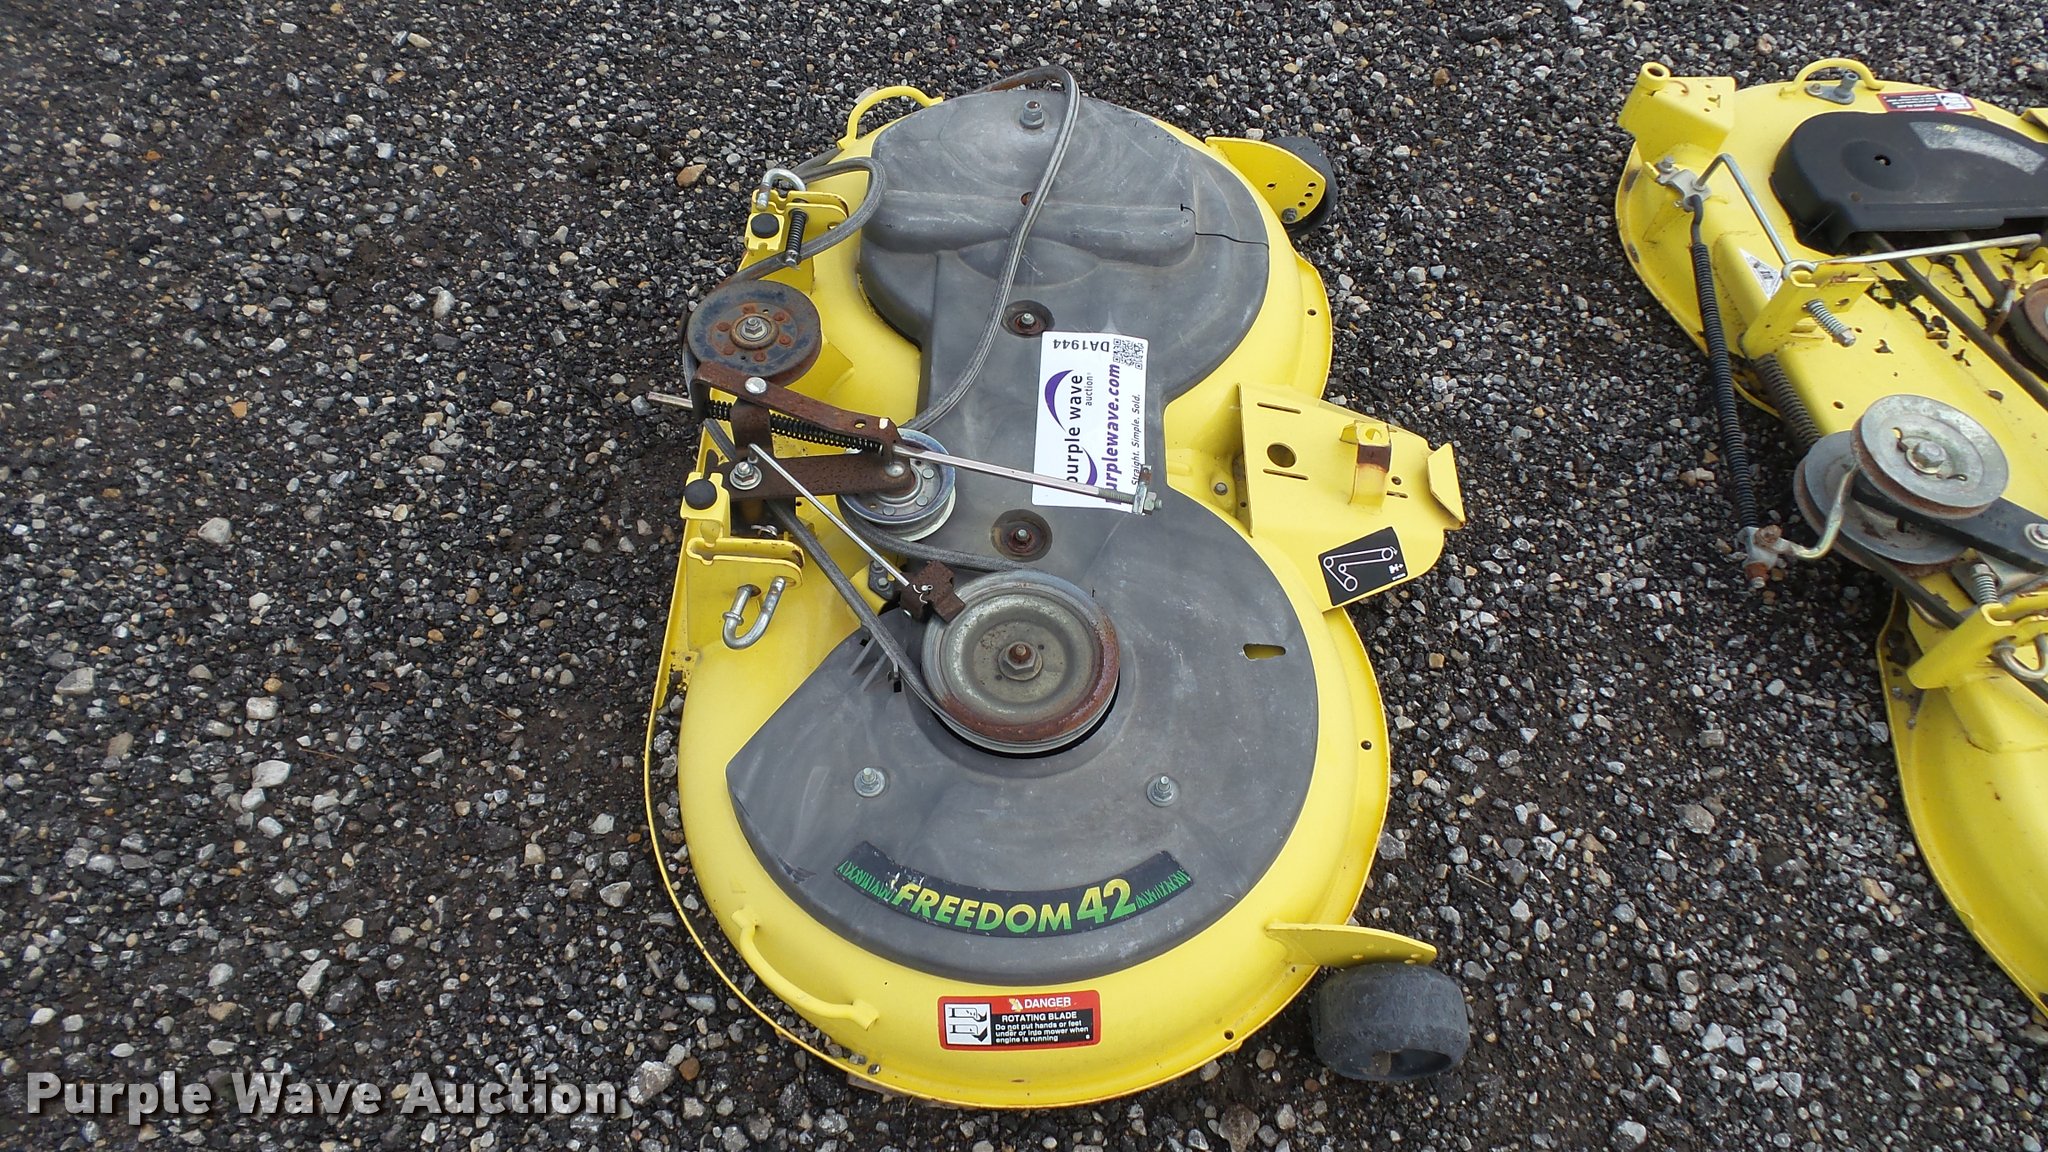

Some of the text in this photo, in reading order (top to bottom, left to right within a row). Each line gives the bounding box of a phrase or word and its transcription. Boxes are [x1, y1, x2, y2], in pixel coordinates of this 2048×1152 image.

[1053, 339, 1110, 352] DA1944
[1085, 375, 1094, 406] auction
[1069, 375, 1083, 420] wave
[1131, 394, 1141, 486] Straight. Simple. Sold.
[892, 878, 1138, 933] FREEDOM 42
[1024, 997, 1071, 1009] DANGER
[1001, 1011, 1077, 1023] ROTATING BLADE
[1021, 1023, 1034, 1031] put
[1030, 1035, 1058, 1043] running
